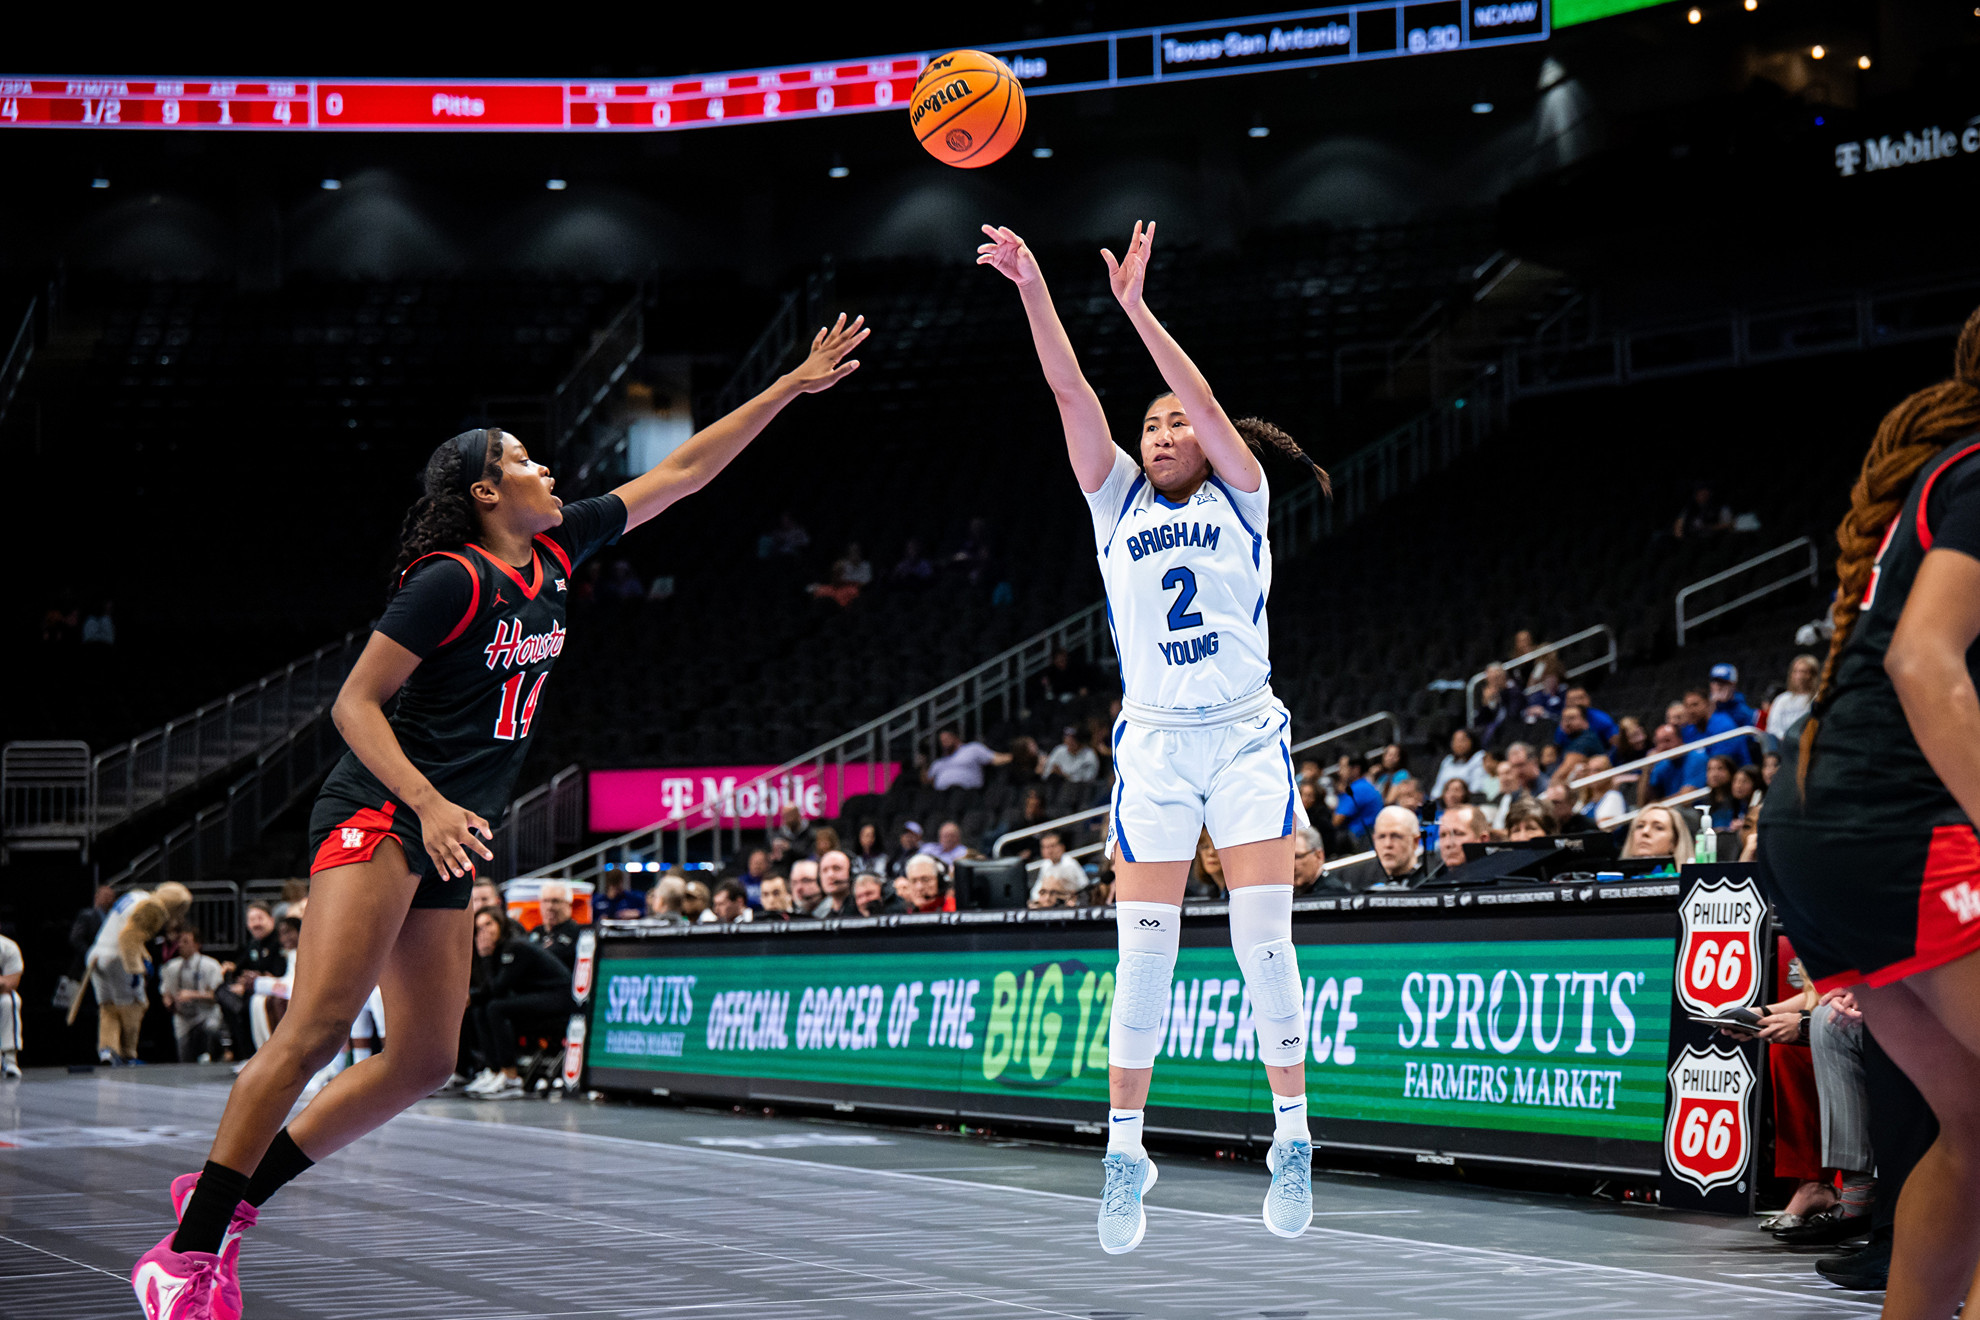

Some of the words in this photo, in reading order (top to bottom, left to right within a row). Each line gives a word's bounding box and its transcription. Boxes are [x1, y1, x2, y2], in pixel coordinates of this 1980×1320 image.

[1267, 21, 1350, 53] Antonio
[1, 97, 19, 122] 4
[81, 97, 121, 125] 1/2
[162, 99, 180, 124] 9
[217, 100, 233, 124] 1
[272, 101, 292, 125] 4
[325, 92, 344, 116] 0
[594, 102, 611, 128] 1
[652, 102, 671, 127] 0
[706, 97, 725, 121] 4
[763, 92, 781, 117] 2
[816, 87, 835, 112] 0
[874, 81, 893, 107] 0
[912, 79, 973, 126] Wilson
[1864, 125, 1958, 172] Mobile
[1126, 522, 1221, 562] BRIGHAM
[1161, 565, 1204, 632] 2
[484, 617, 566, 670] Housto
[1158, 631, 1219, 666] YOUNG
[493, 671, 549, 740] 14
[701, 774, 827, 818] Mobile
[1693, 902, 1752, 925] PHILLIPS
[1691, 939, 1746, 990] 66
[605, 974, 697, 1026] SPROUTS
[706, 990, 790, 1050] OFFICIAL
[796, 984, 884, 1050] GROCER
[887, 981, 924, 1048] OF
[927, 978, 980, 1049] THE
[982, 962, 1064, 1080] BIG
[1071, 970, 1115, 1078] 12
[1398, 969, 1637, 1056] SPROUTS
[1403, 1061, 1508, 1104] FARMERS
[1511, 1066, 1622, 1110] MARKET
[1682, 1068, 1741, 1094] PHILLIPS
[1681, 1106, 1735, 1160] 66
